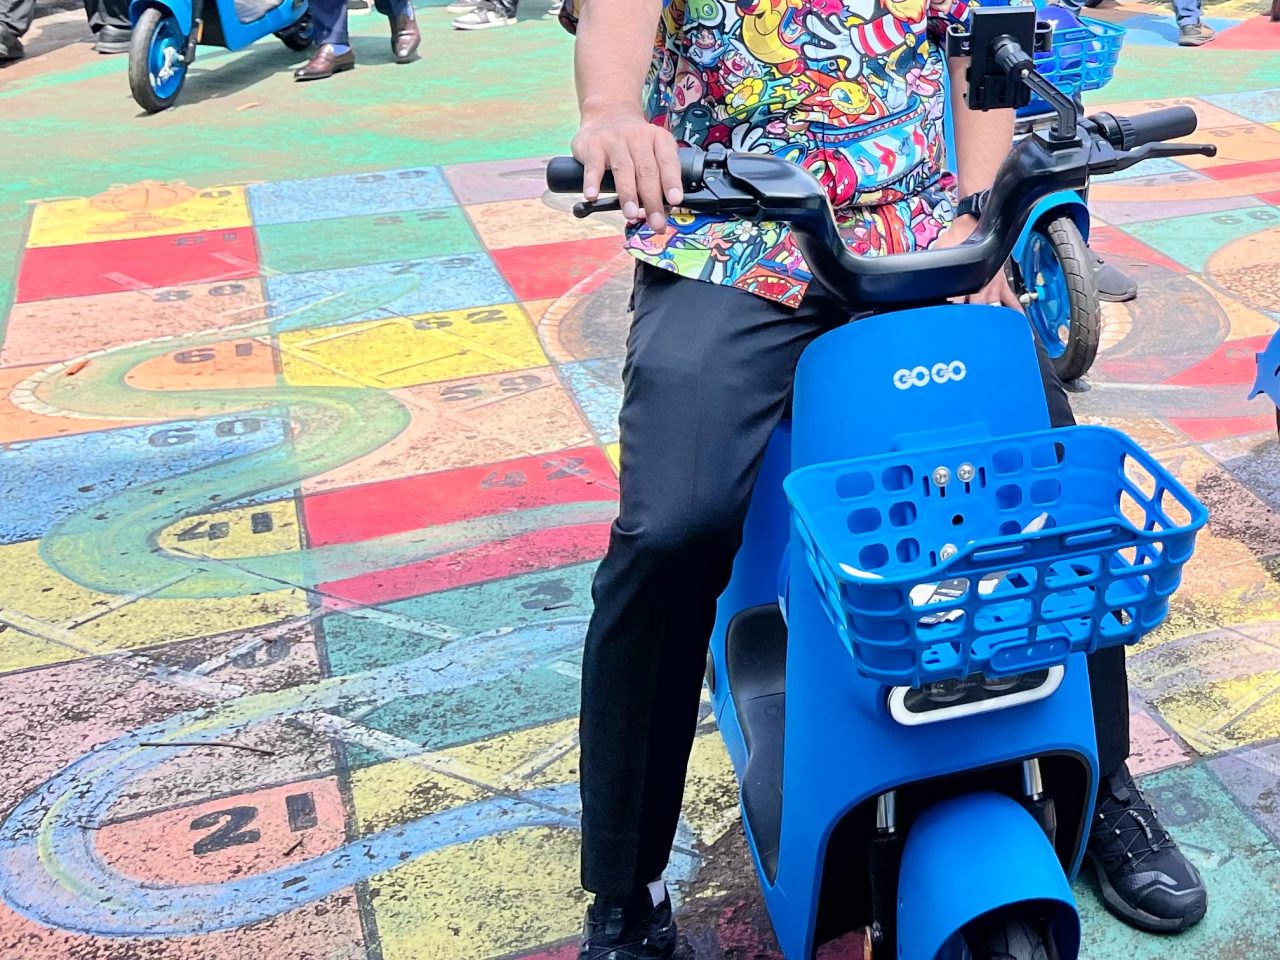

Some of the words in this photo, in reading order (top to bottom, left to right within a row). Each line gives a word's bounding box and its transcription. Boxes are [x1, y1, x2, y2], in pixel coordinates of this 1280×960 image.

[1210, 209, 1279, 226] 66
[174, 342, 253, 364] 61
[439, 374, 542, 402] 59
[893, 360, 967, 390] GOGO
[148, 418, 262, 447] 60
[479, 456, 590, 489] 42
[177, 512, 274, 541] 41
[189, 790, 316, 856] 21
